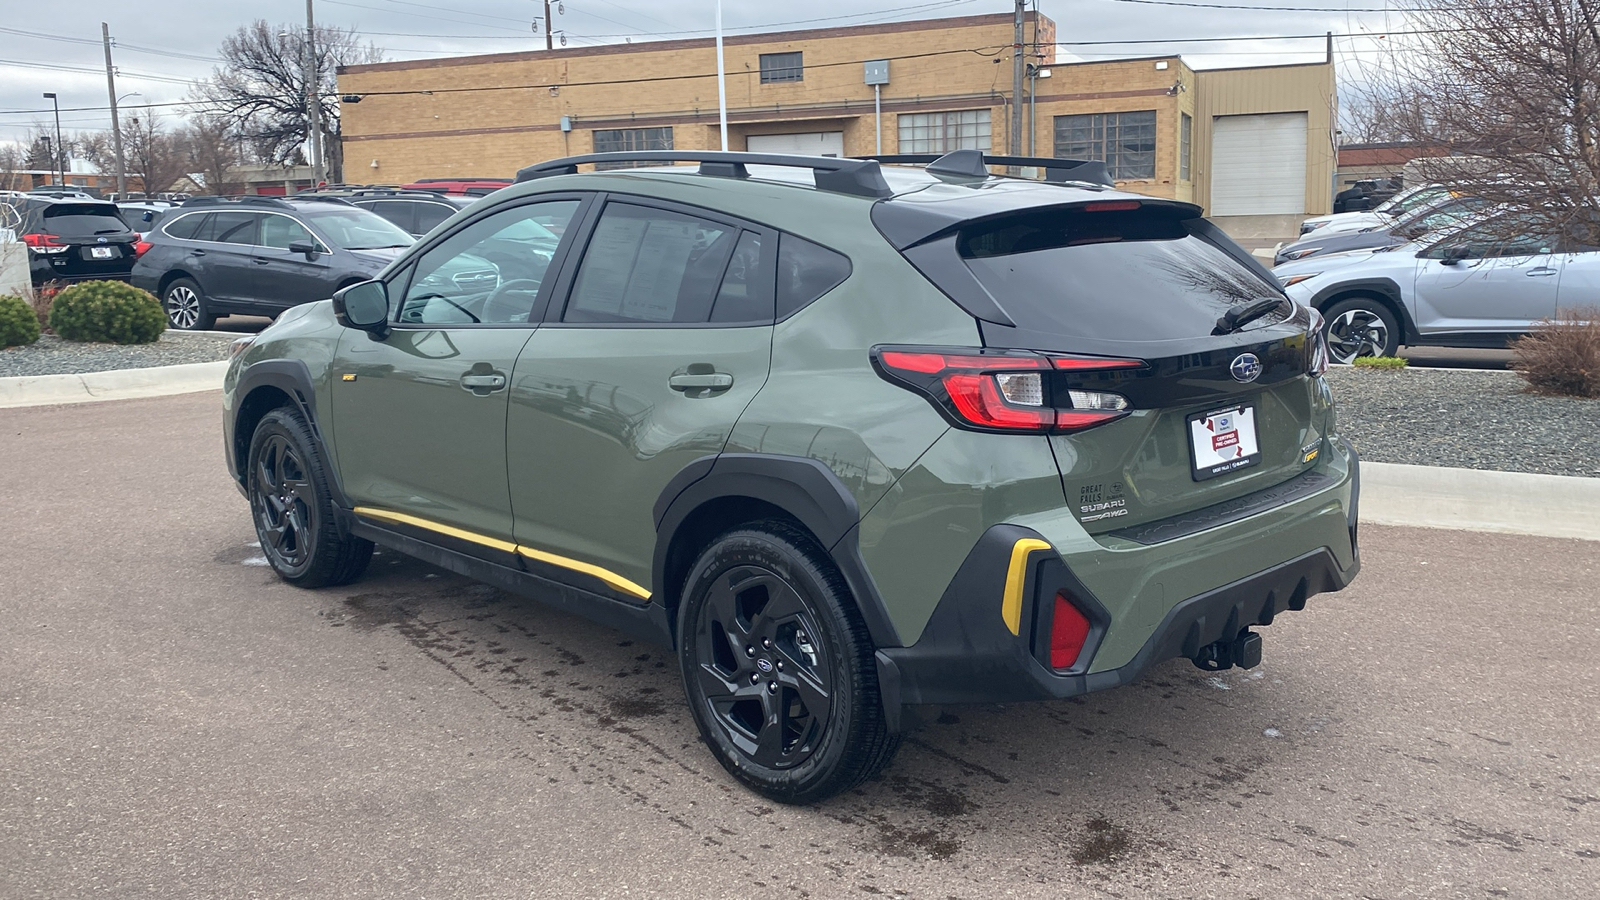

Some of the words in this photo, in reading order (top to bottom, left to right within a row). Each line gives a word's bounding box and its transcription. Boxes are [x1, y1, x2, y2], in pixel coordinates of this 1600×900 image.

[1217, 433, 1234, 441] CERTIFIED
[1215, 438, 1237, 447] PRE-OWNED
[1080, 484, 1102, 494] GREAT
[1080, 493, 1101, 503] FALLS
[1081, 500, 1125, 512] SUBARU
